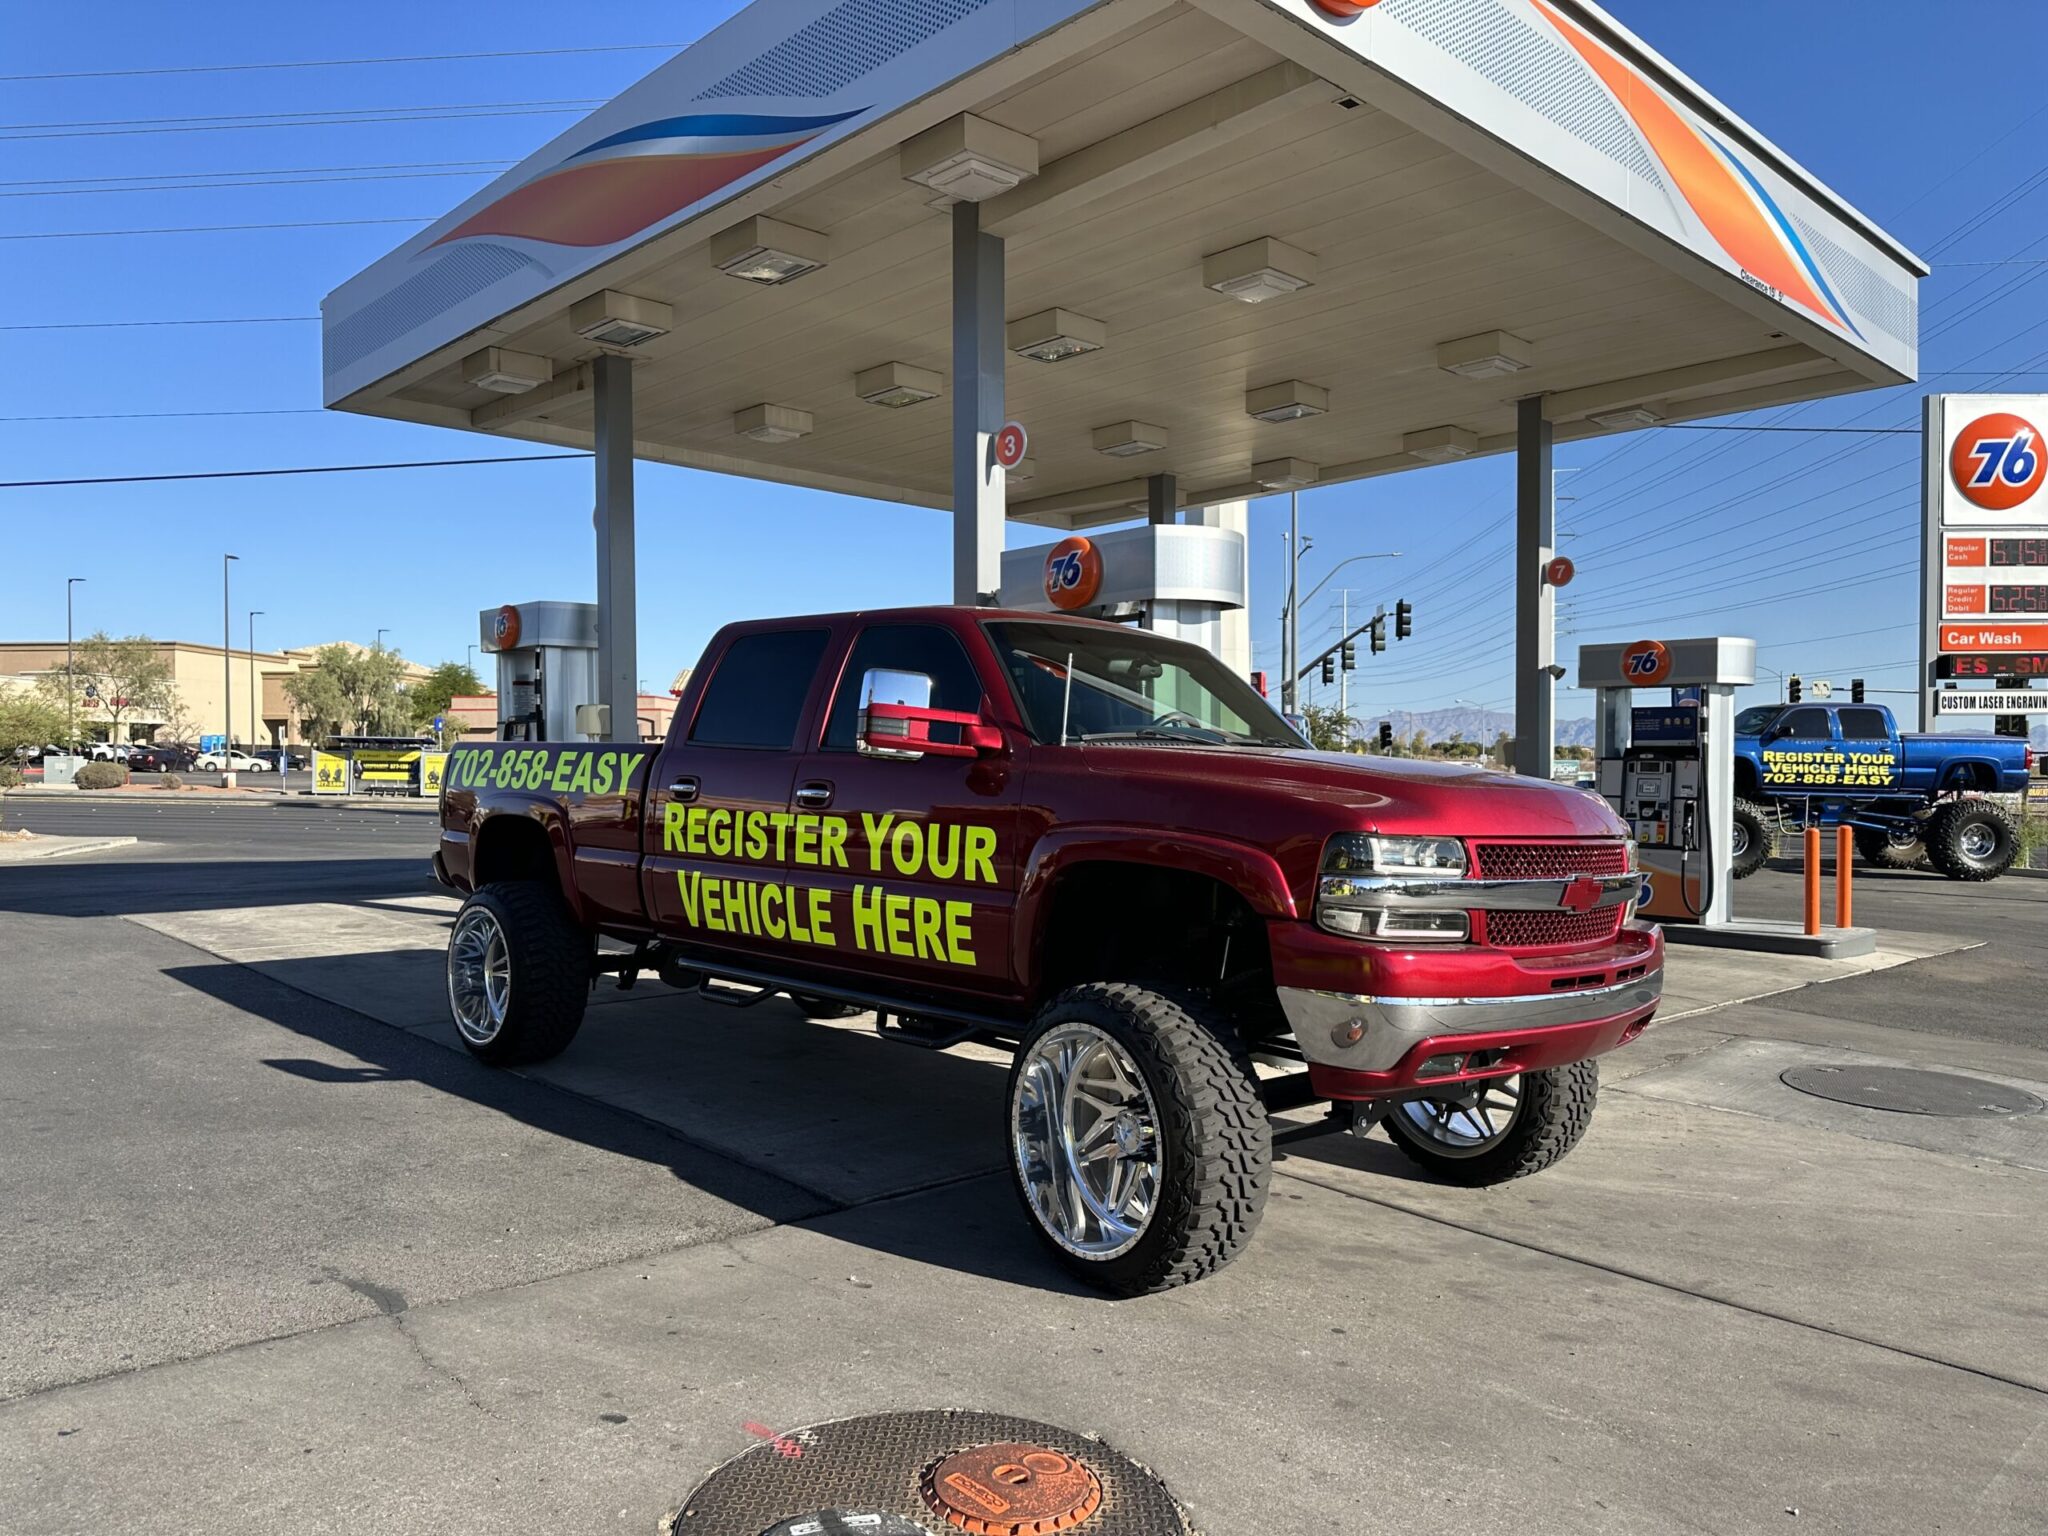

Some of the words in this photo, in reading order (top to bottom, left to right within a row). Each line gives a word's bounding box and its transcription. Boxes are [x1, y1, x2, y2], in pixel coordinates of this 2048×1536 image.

[1741, 268, 1768, 294] Clearance
[1004, 435, 1016, 457] 3
[1969, 432, 2035, 487] 76
[1948, 553, 1968, 561] Cash
[1050, 551, 1083, 592] 76
[1555, 564, 1565, 579] 7
[494, 613, 509, 638] 76
[1947, 632, 1975, 645] Car
[1979, 632, 2022, 645] Wash
[1628, 650, 1658, 676] 76
[1956, 657, 1988, 674] ES
[1941, 695, 1976, 709] CUSTOM
[1978, 695, 2004, 709] LASER
[1763, 751, 1845, 763] REGISTER
[1848, 752, 1895, 765] YOUR
[1769, 763, 1840, 774] VEHICLE
[1845, 764, 1889, 775] HERE
[449, 748, 646, 796] 702-858-EASY
[1763, 773, 1895, 785] 702-858-EASY
[663, 802, 849, 869] REGISTER
[861, 812, 999, 884] YOUR
[676, 869, 837, 947] VEHICLE
[852, 884, 977, 967] HERE
